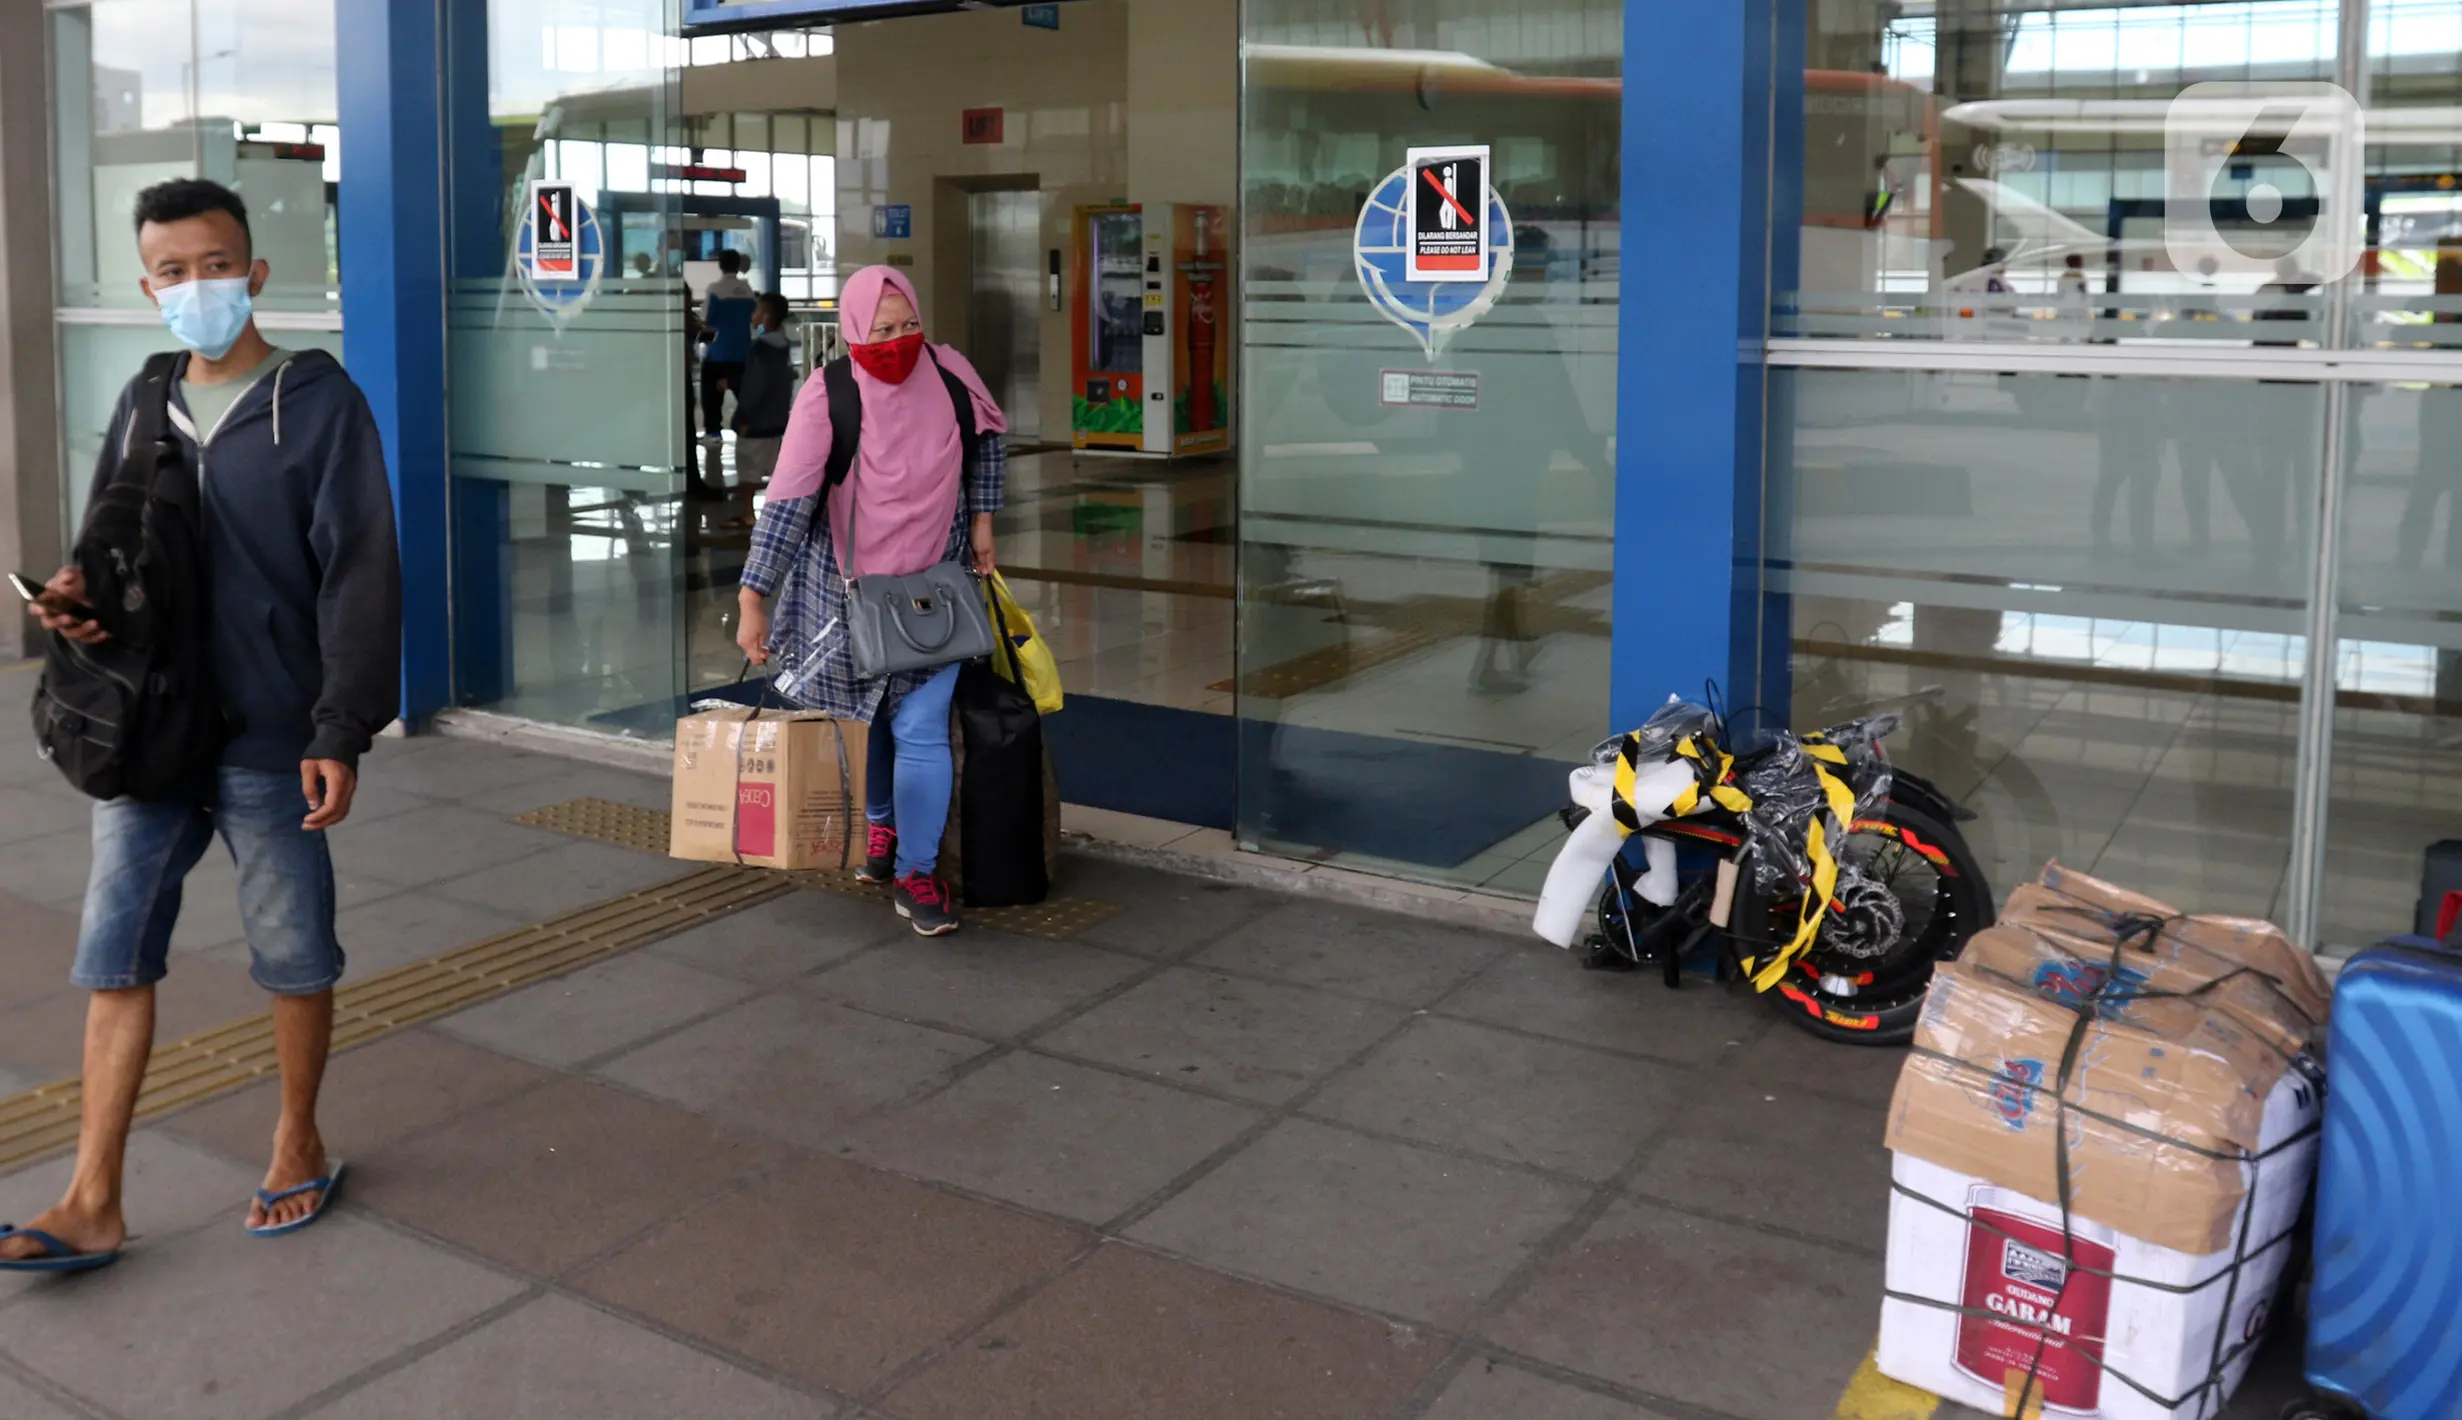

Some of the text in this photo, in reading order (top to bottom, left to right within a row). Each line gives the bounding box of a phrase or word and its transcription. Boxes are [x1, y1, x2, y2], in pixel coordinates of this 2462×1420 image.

[968, 114, 997, 137] LIFT
[1418, 231, 1478, 240] DILARANG BERSANDAR
[1419, 246, 1477, 254] PLEASE DO NOT LEAN
[1410, 375, 1476, 387] PINTU OTOMATIS
[1986, 1292, 2072, 1336] GARAM
